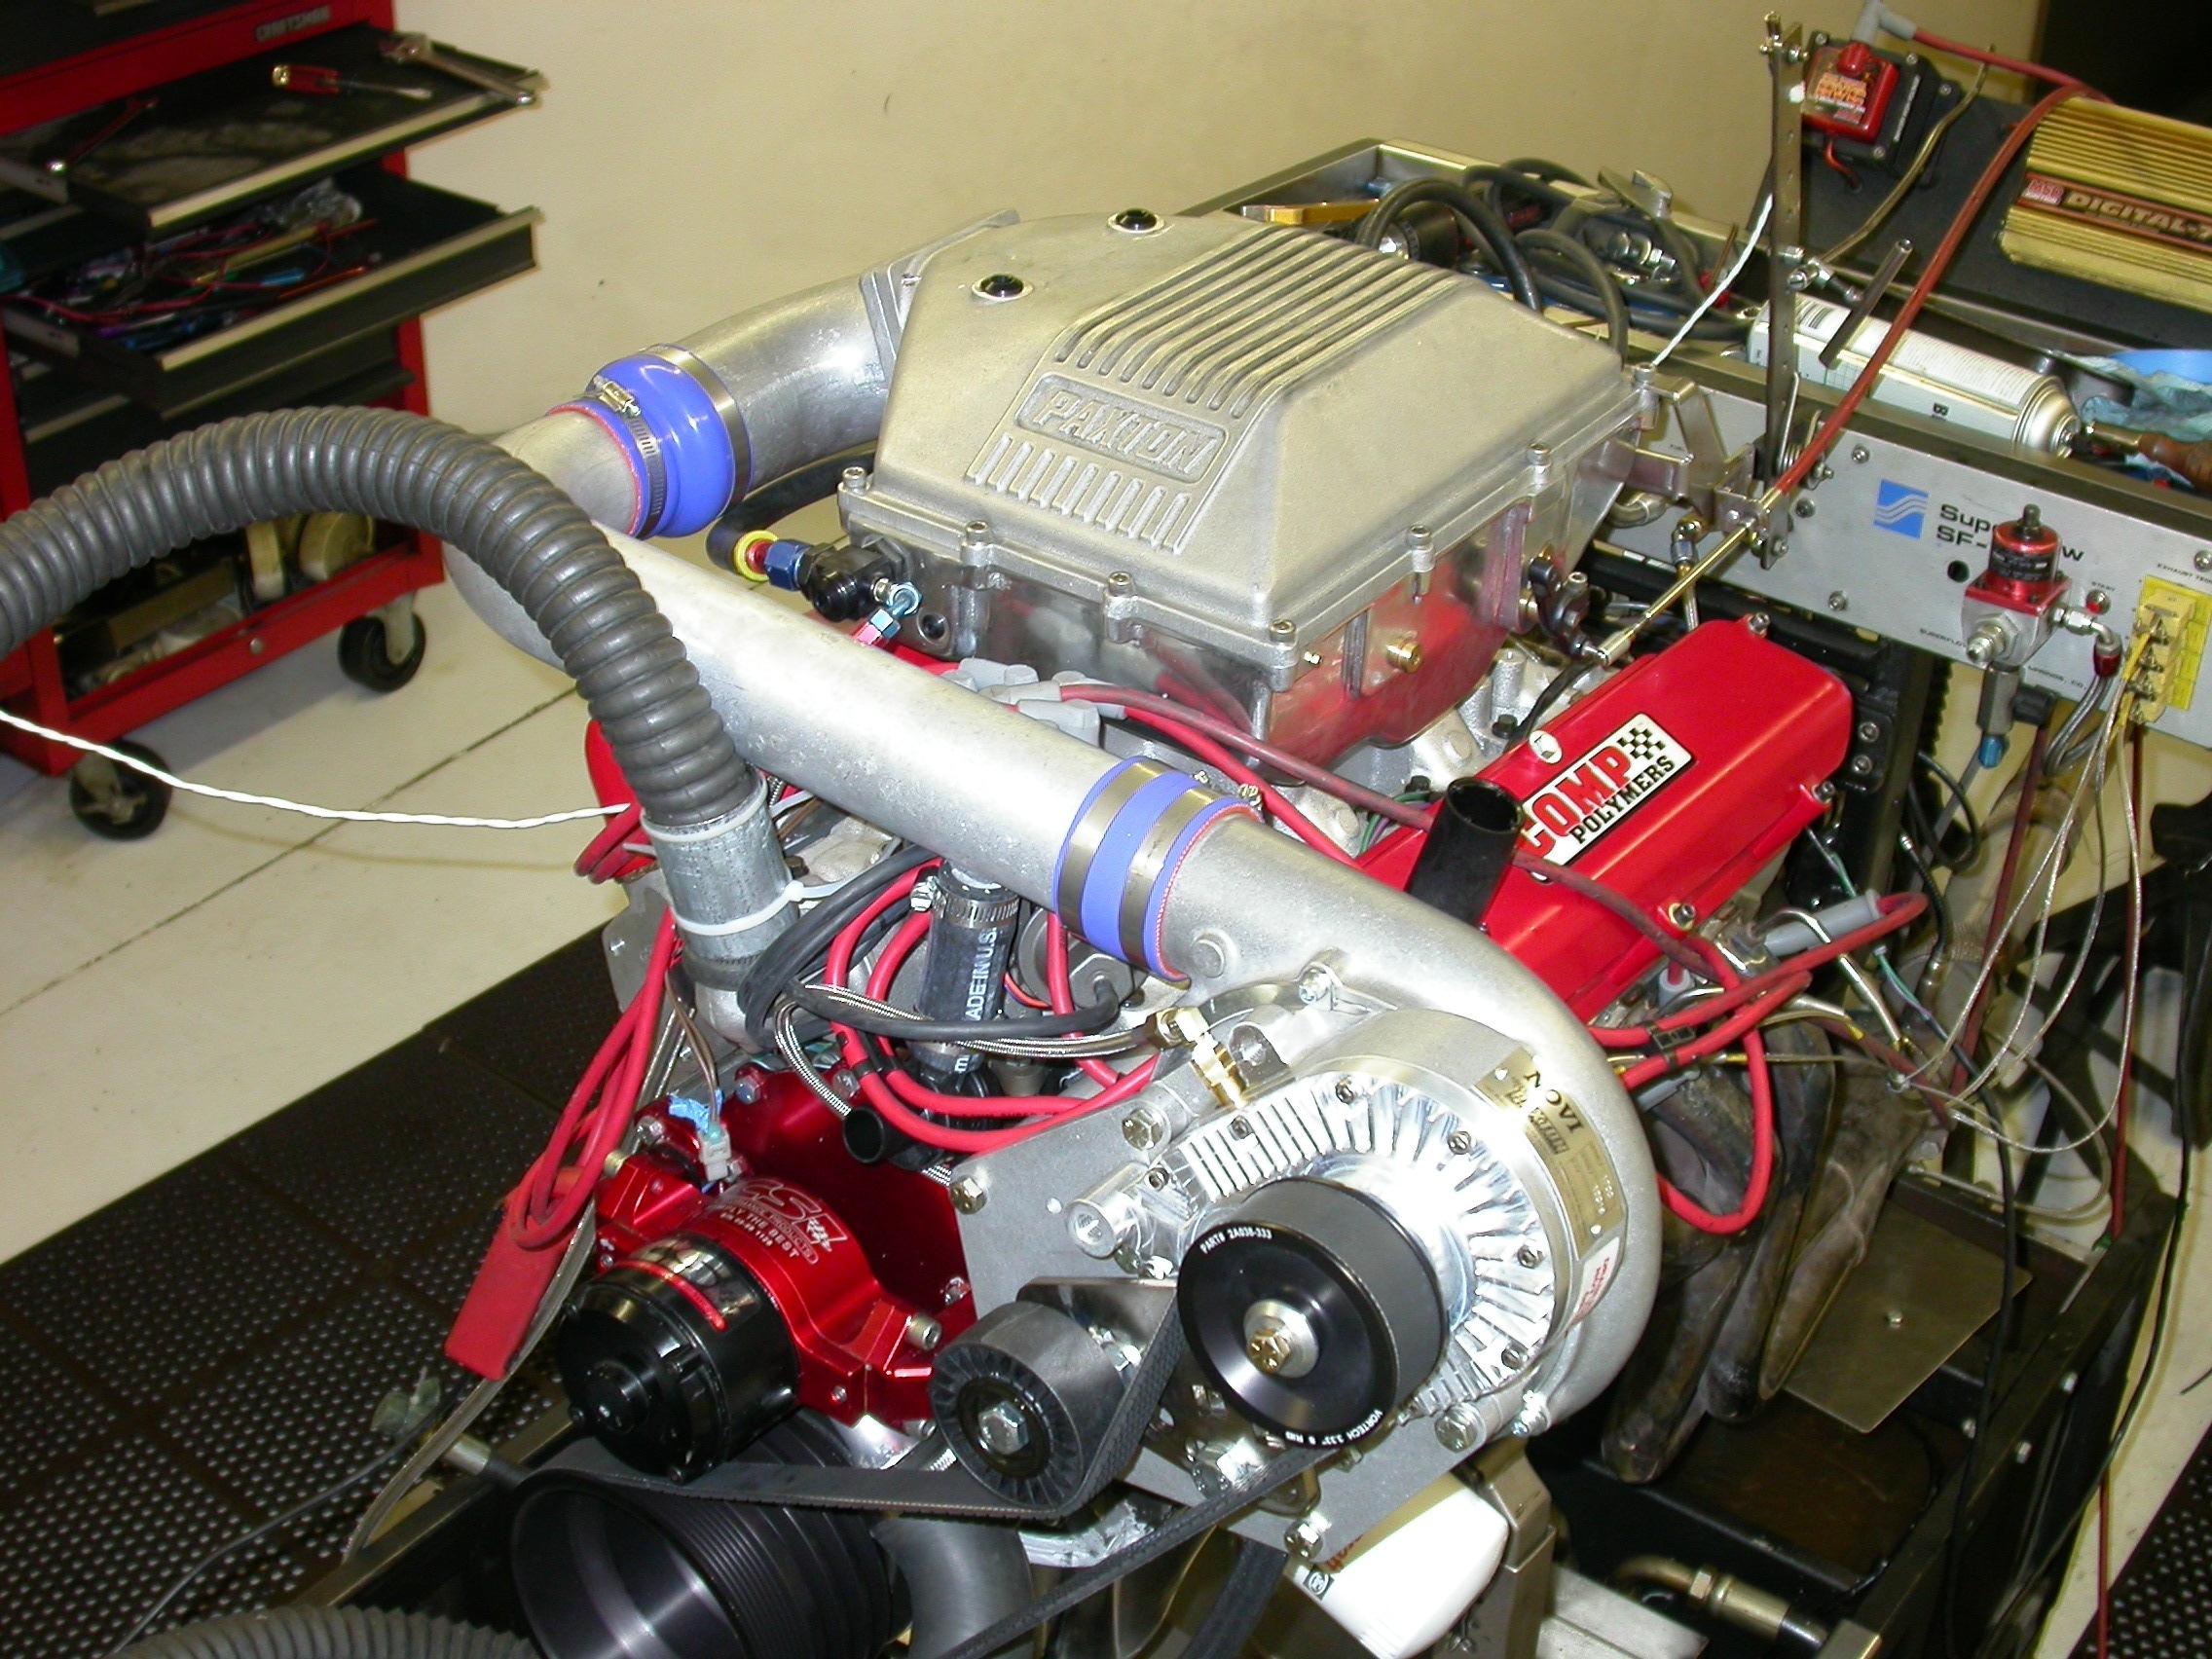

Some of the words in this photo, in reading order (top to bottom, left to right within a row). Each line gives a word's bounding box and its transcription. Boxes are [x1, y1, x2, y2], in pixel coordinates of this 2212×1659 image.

[1032, 389, 1218, 474] PAXTON
[1516, 745, 1632, 859] COMP
[1568, 754, 1677, 845] POLYMERS
[1524, 1070, 1585, 1134] NOVI
[768, 1228, 799, 1258] BEST
[1346, 1408, 1383, 1441] VORTECH
